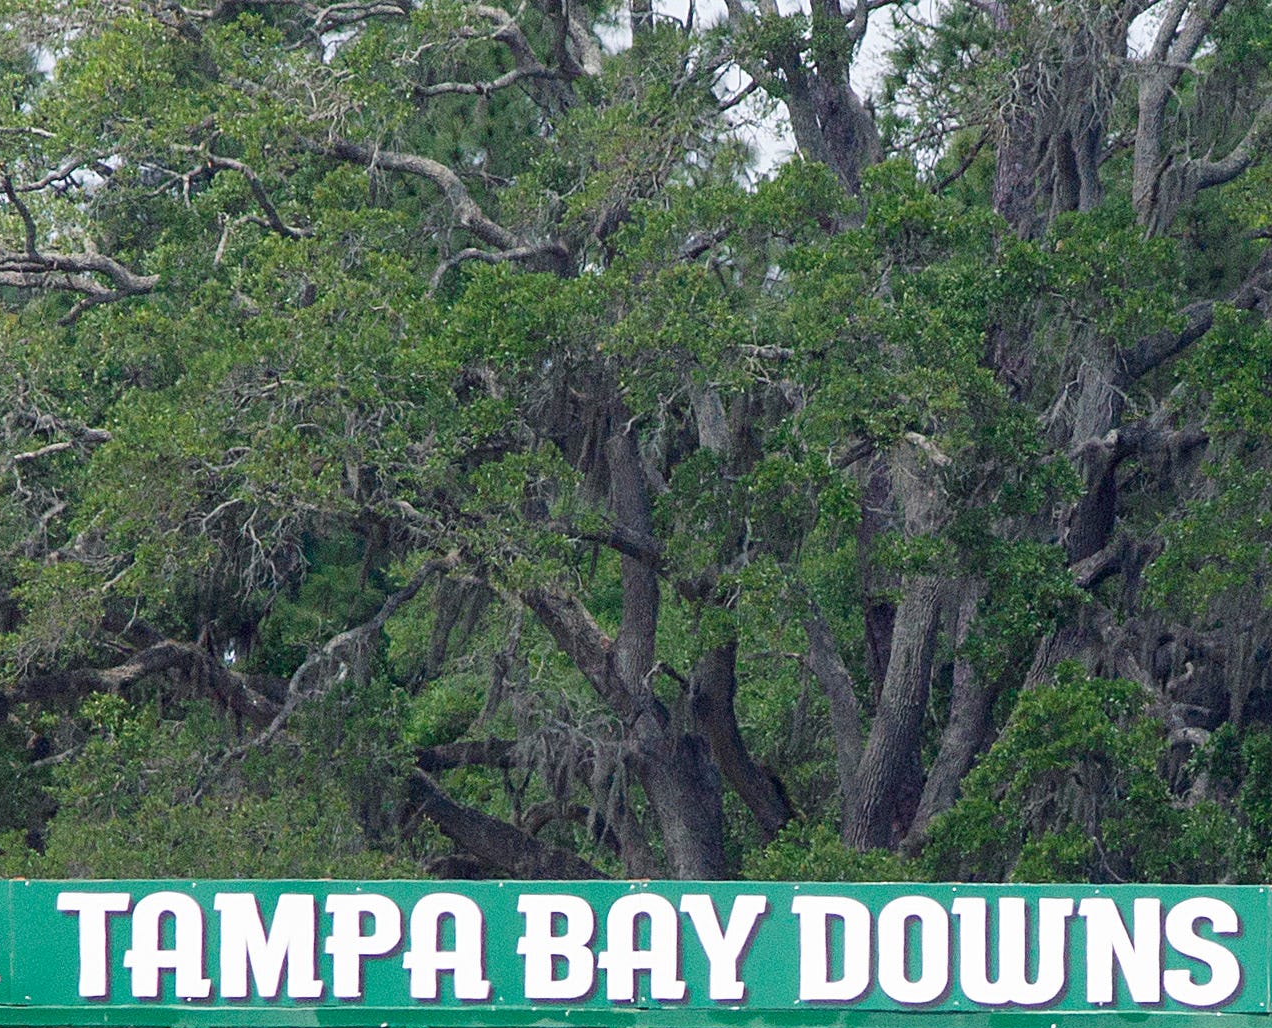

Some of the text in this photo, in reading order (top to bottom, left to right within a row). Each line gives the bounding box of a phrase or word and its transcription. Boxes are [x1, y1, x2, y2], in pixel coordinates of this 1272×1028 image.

[57, 892, 1240, 1006] TAMPA BAY DOWNS
